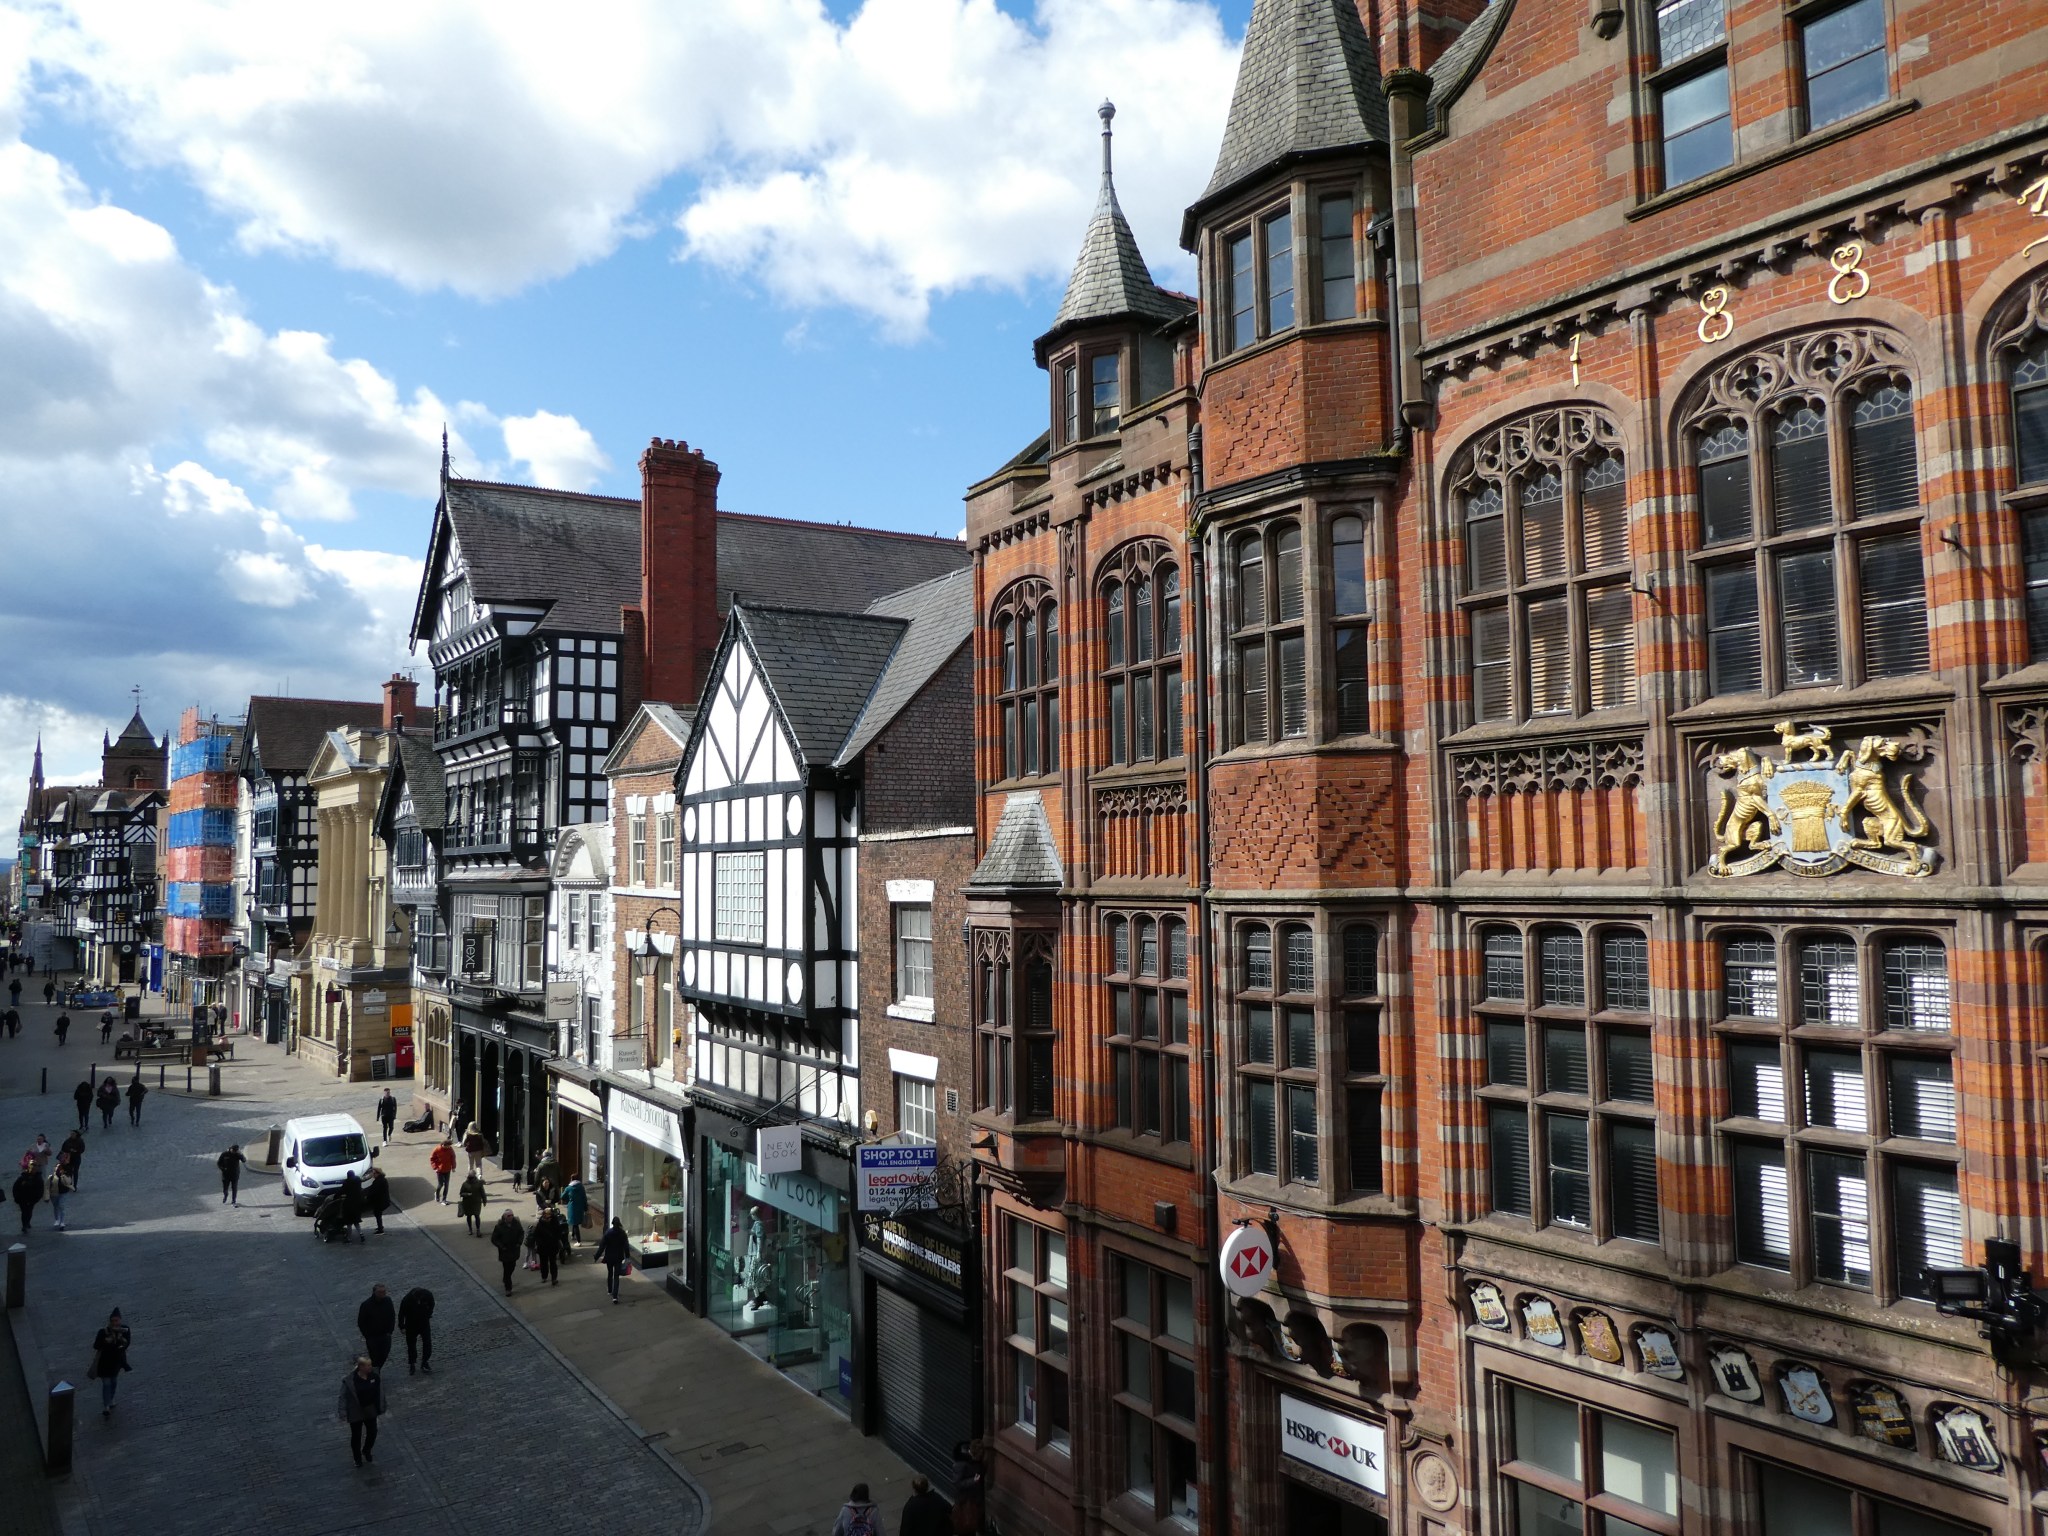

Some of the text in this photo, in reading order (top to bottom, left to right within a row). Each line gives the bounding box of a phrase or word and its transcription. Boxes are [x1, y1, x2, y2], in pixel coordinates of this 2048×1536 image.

[1697, 287, 1734, 343] 8
[1828, 243, 1870, 305] 8
[1799, 865, 1824, 876] NON
[1852, 850, 1898, 873] STEMMA
[465, 938, 476, 969] next
[620, 1092, 642, 1119] Russell
[764, 1147, 797, 1160] LOOK
[766, 1140, 795, 1151] NEW
[863, 1149, 936, 1160] SHOP TO LET
[749, 1164, 827, 1213] NEW LOOK
[868, 1187, 896, 1196] 01244
[882, 1220, 897, 1233] DUE
[897, 1223, 908, 1238] TO
[924, 1236, 935, 1250] OF
[935, 1240, 961, 1262] LEASE
[882, 1228, 961, 1275] WALTONS FINE JEWELLERS
[882, 1239, 961, 1289] CLOSING DOWN SALE
[1285, 1417, 1379, 1472] HSBC UK
